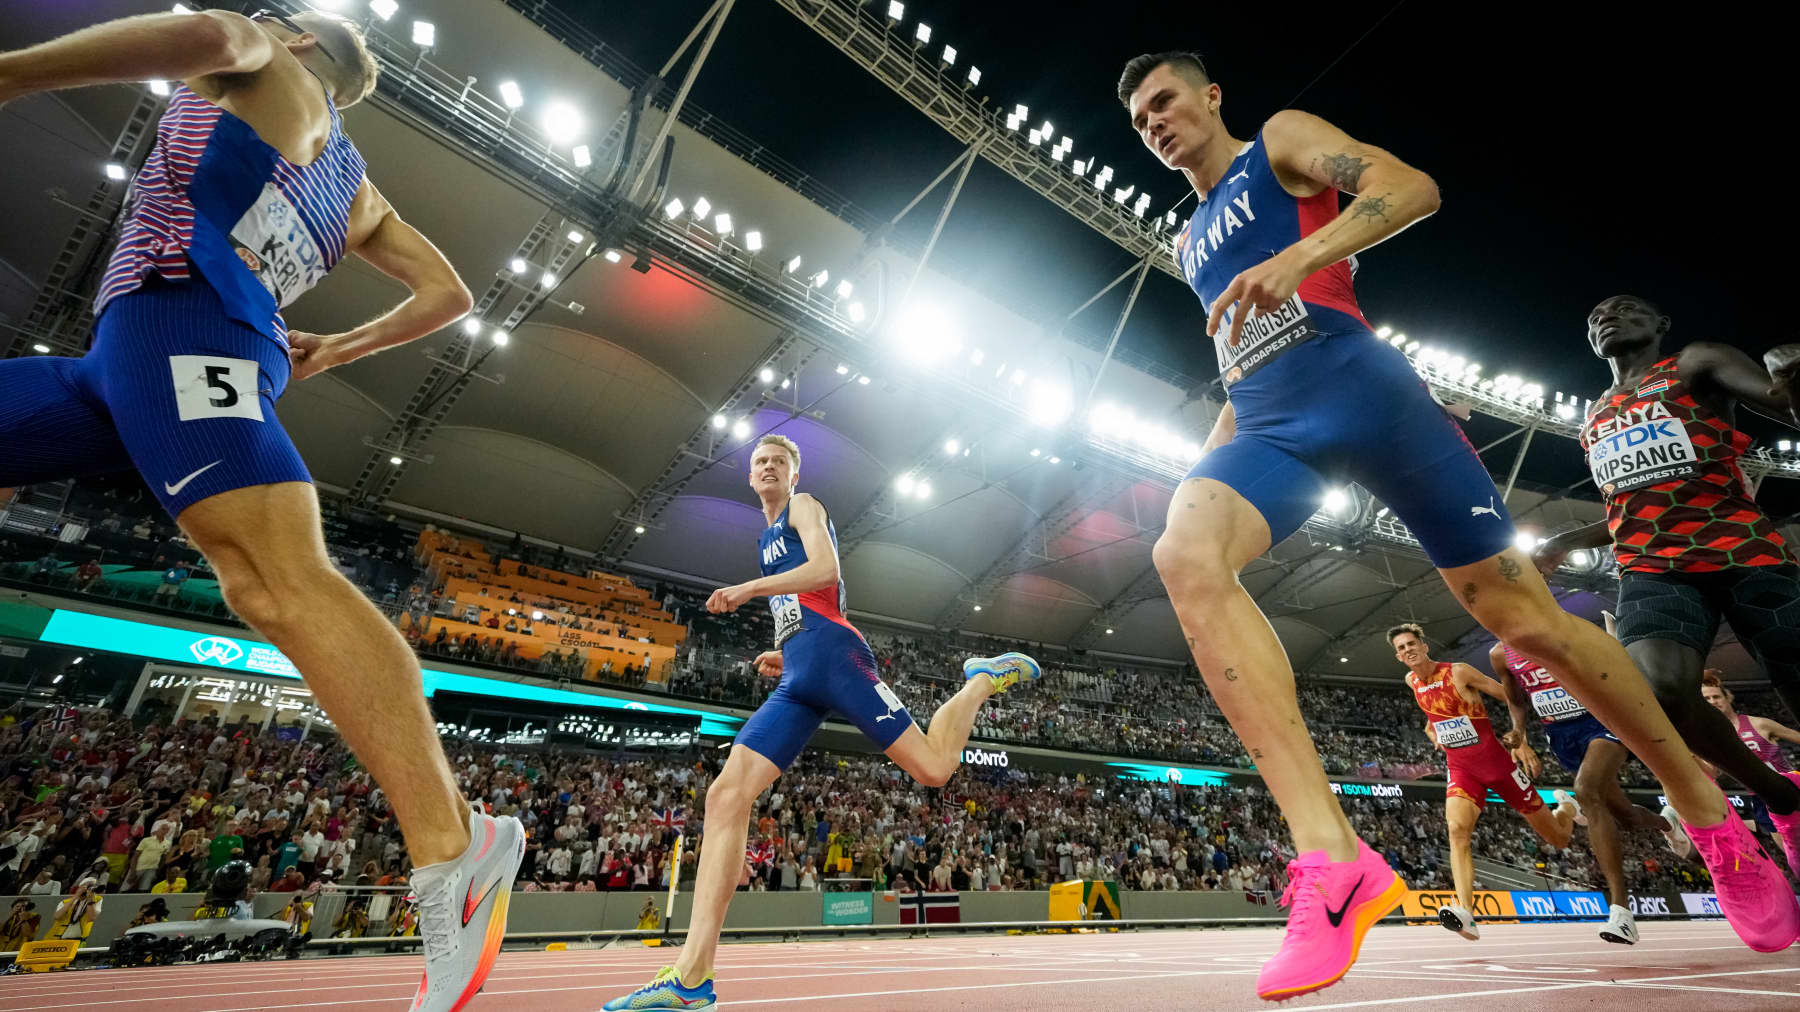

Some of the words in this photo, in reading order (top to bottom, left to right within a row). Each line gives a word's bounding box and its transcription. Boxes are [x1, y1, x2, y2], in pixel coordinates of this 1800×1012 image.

[1241, 333, 1293, 371] BUDAPEST
[1292, 325, 1308, 339] 23
[204, 365, 239, 408] 5
[1606, 420, 1679, 452] TDK
[1595, 442, 1688, 483] KIPSANG
[1617, 469, 1676, 489] BUDAPEST
[1678, 466, 1693, 475] 23
[762, 536, 788, 565] WAY
[1520, 667, 1555, 687] US
[1537, 698, 1580, 716] NUGUS
[1441, 717, 1468, 730] TDK
[1440, 729, 1474, 744] GARCÍA
[965, 749, 1009, 767] DÖNTŐ
[1342, 784, 1371, 796] 1500M
[1418, 893, 1502, 916] SEKO
[1520, 896, 1556, 916] NTN
[1568, 896, 1601, 916] NTN
[1640, 896, 1670, 915] asics
